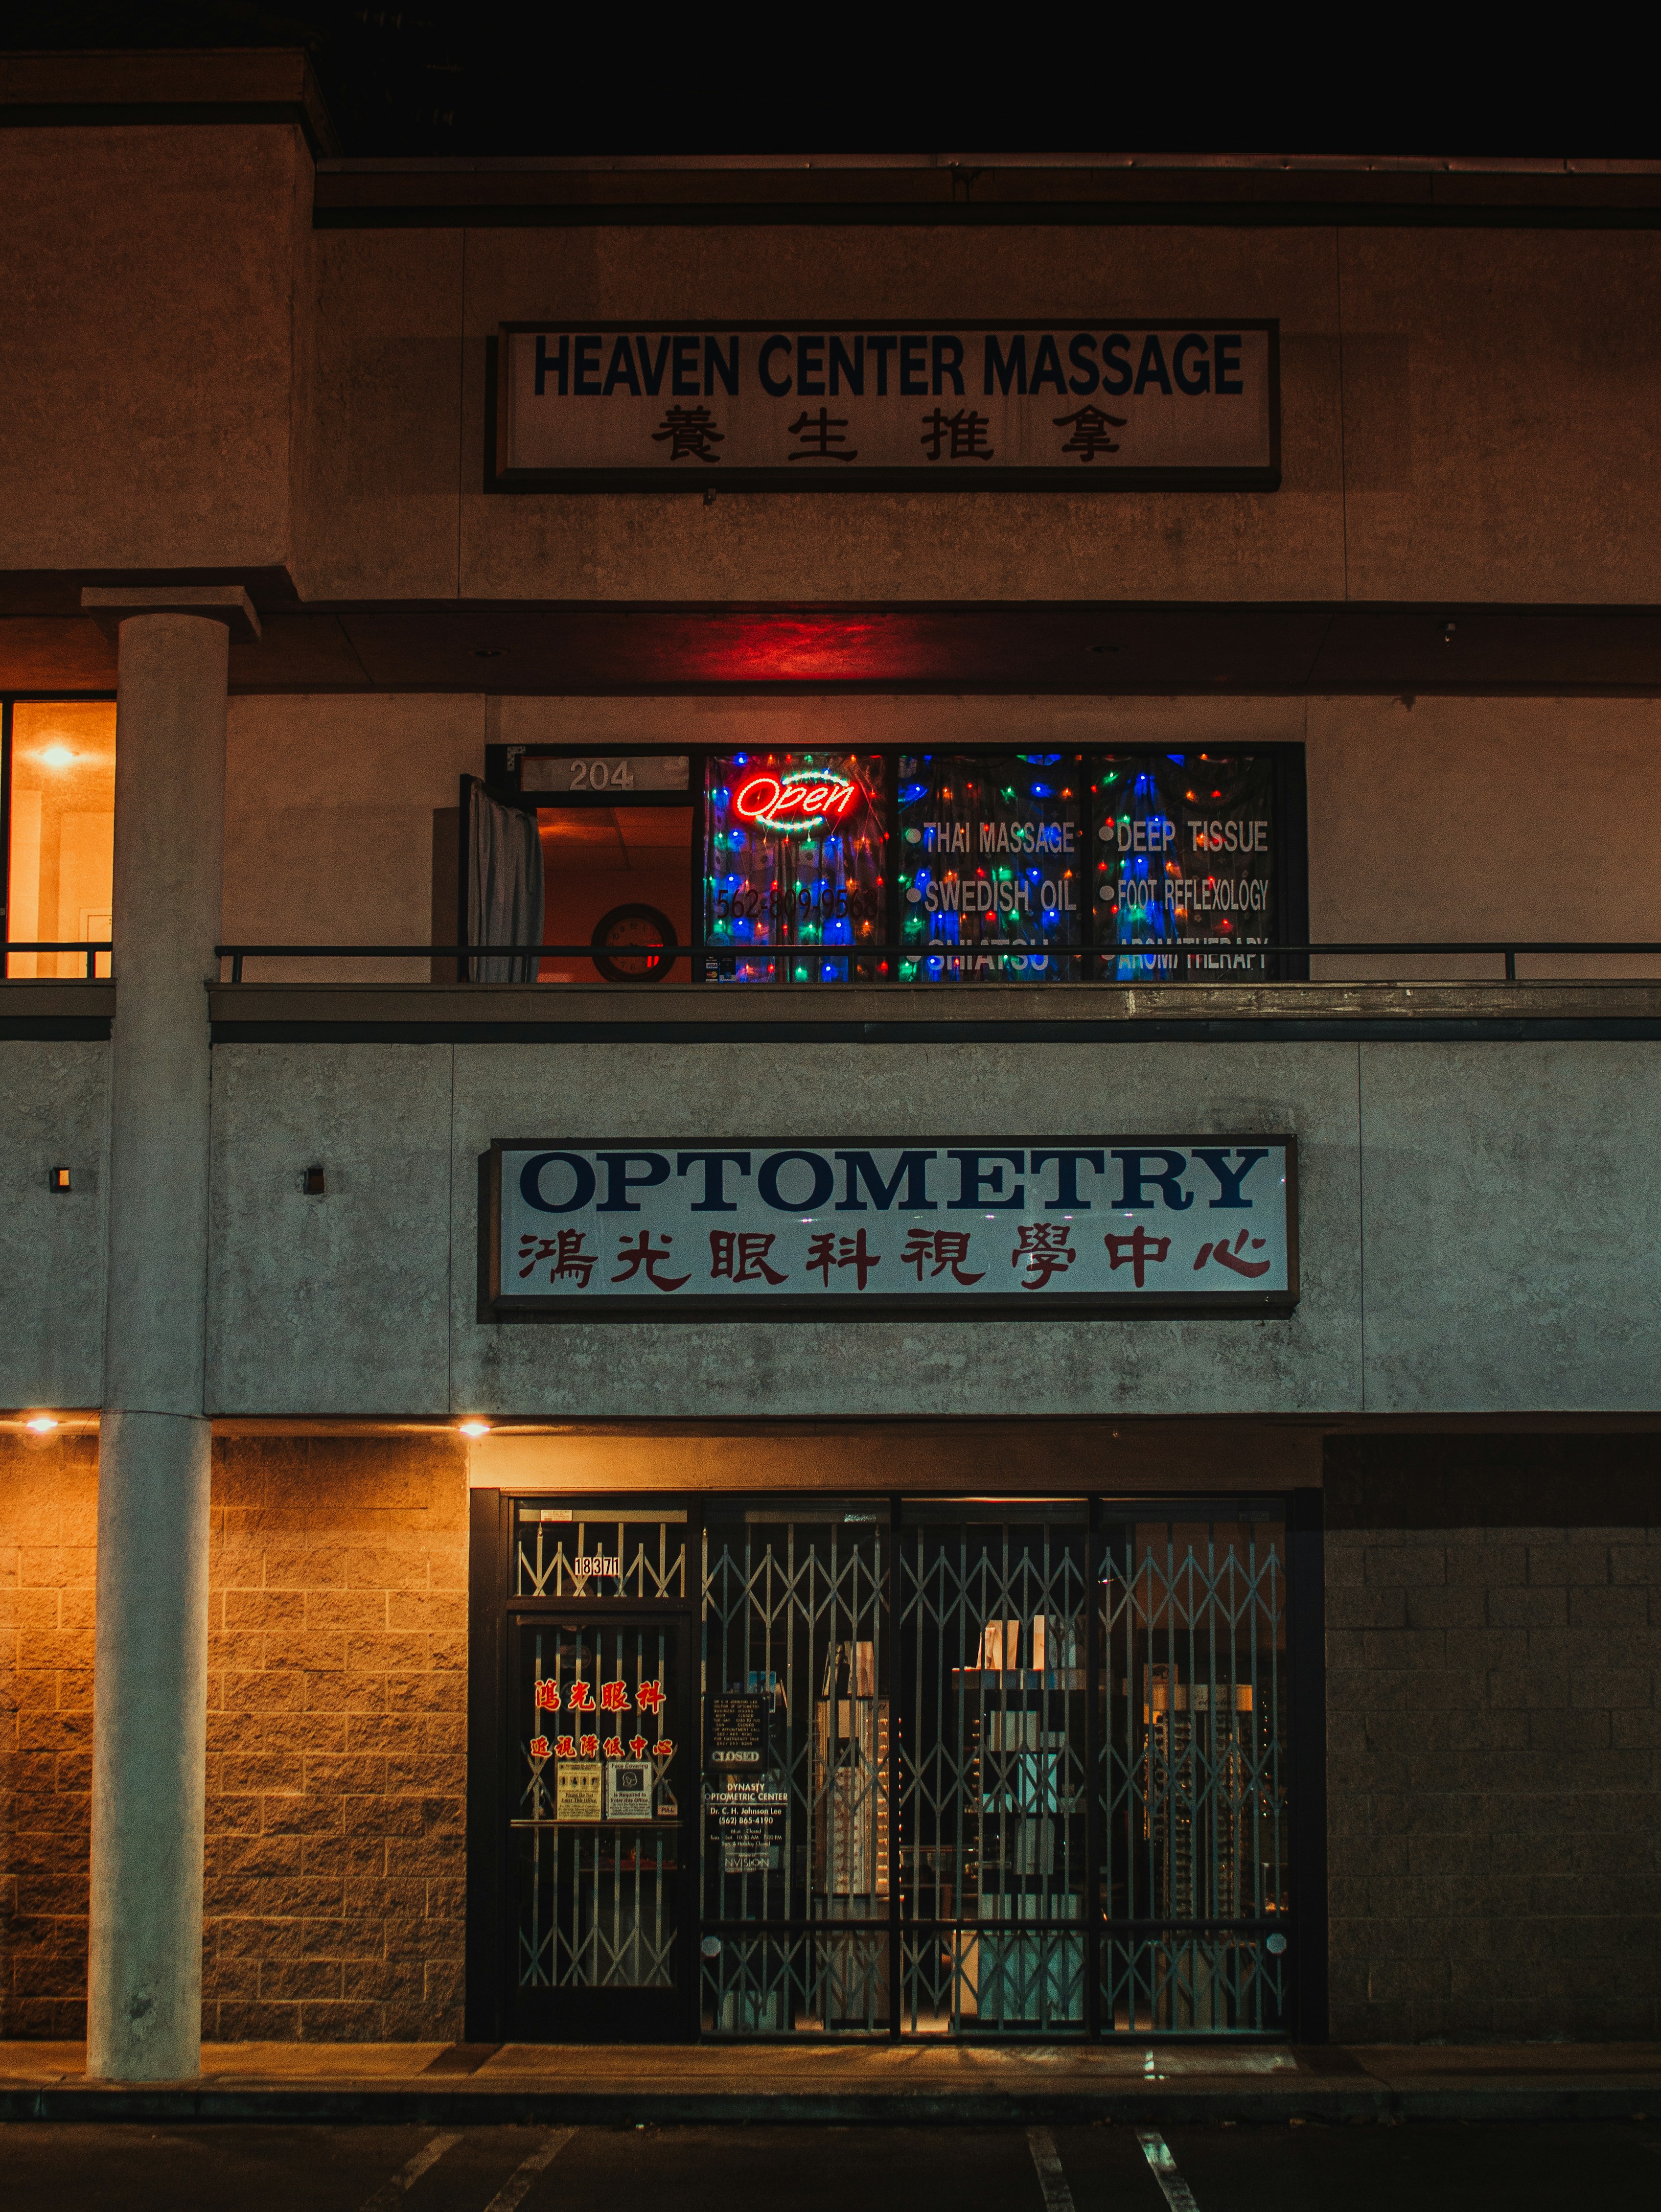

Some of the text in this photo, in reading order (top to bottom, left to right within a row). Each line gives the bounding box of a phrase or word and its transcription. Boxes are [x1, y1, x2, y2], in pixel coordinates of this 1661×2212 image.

[534, 333, 1243, 397] HEAVEN CENTER MASSAGE
[651, 404, 1128, 463] 養生推拿
[570, 760, 632, 791] 204
[737, 778, 854, 819] Open
[923, 821, 1075, 853] THAI MASSAGE
[1117, 820, 1268, 853] DEEP TISSUE
[717, 888, 878, 920] 562-809-9568
[924, 879, 1077, 912] SWEDISH OIL
[1118, 879, 1269, 911] FOOT REFLEXOLOGY
[927, 939, 1049, 971] SHIATSU
[519, 1149, 1269, 1213] OPTOMETRY
[518, 1222, 1271, 1292] 鴻光眼科視學中心
[576, 1558, 619, 1575] 18371
[712, 1751, 760, 1761] CLOSED
[727, 1783, 765, 1791] DYNASTY
[758, 1793, 788, 1801] CENTER
[719, 1817, 737, 1825] (562)
